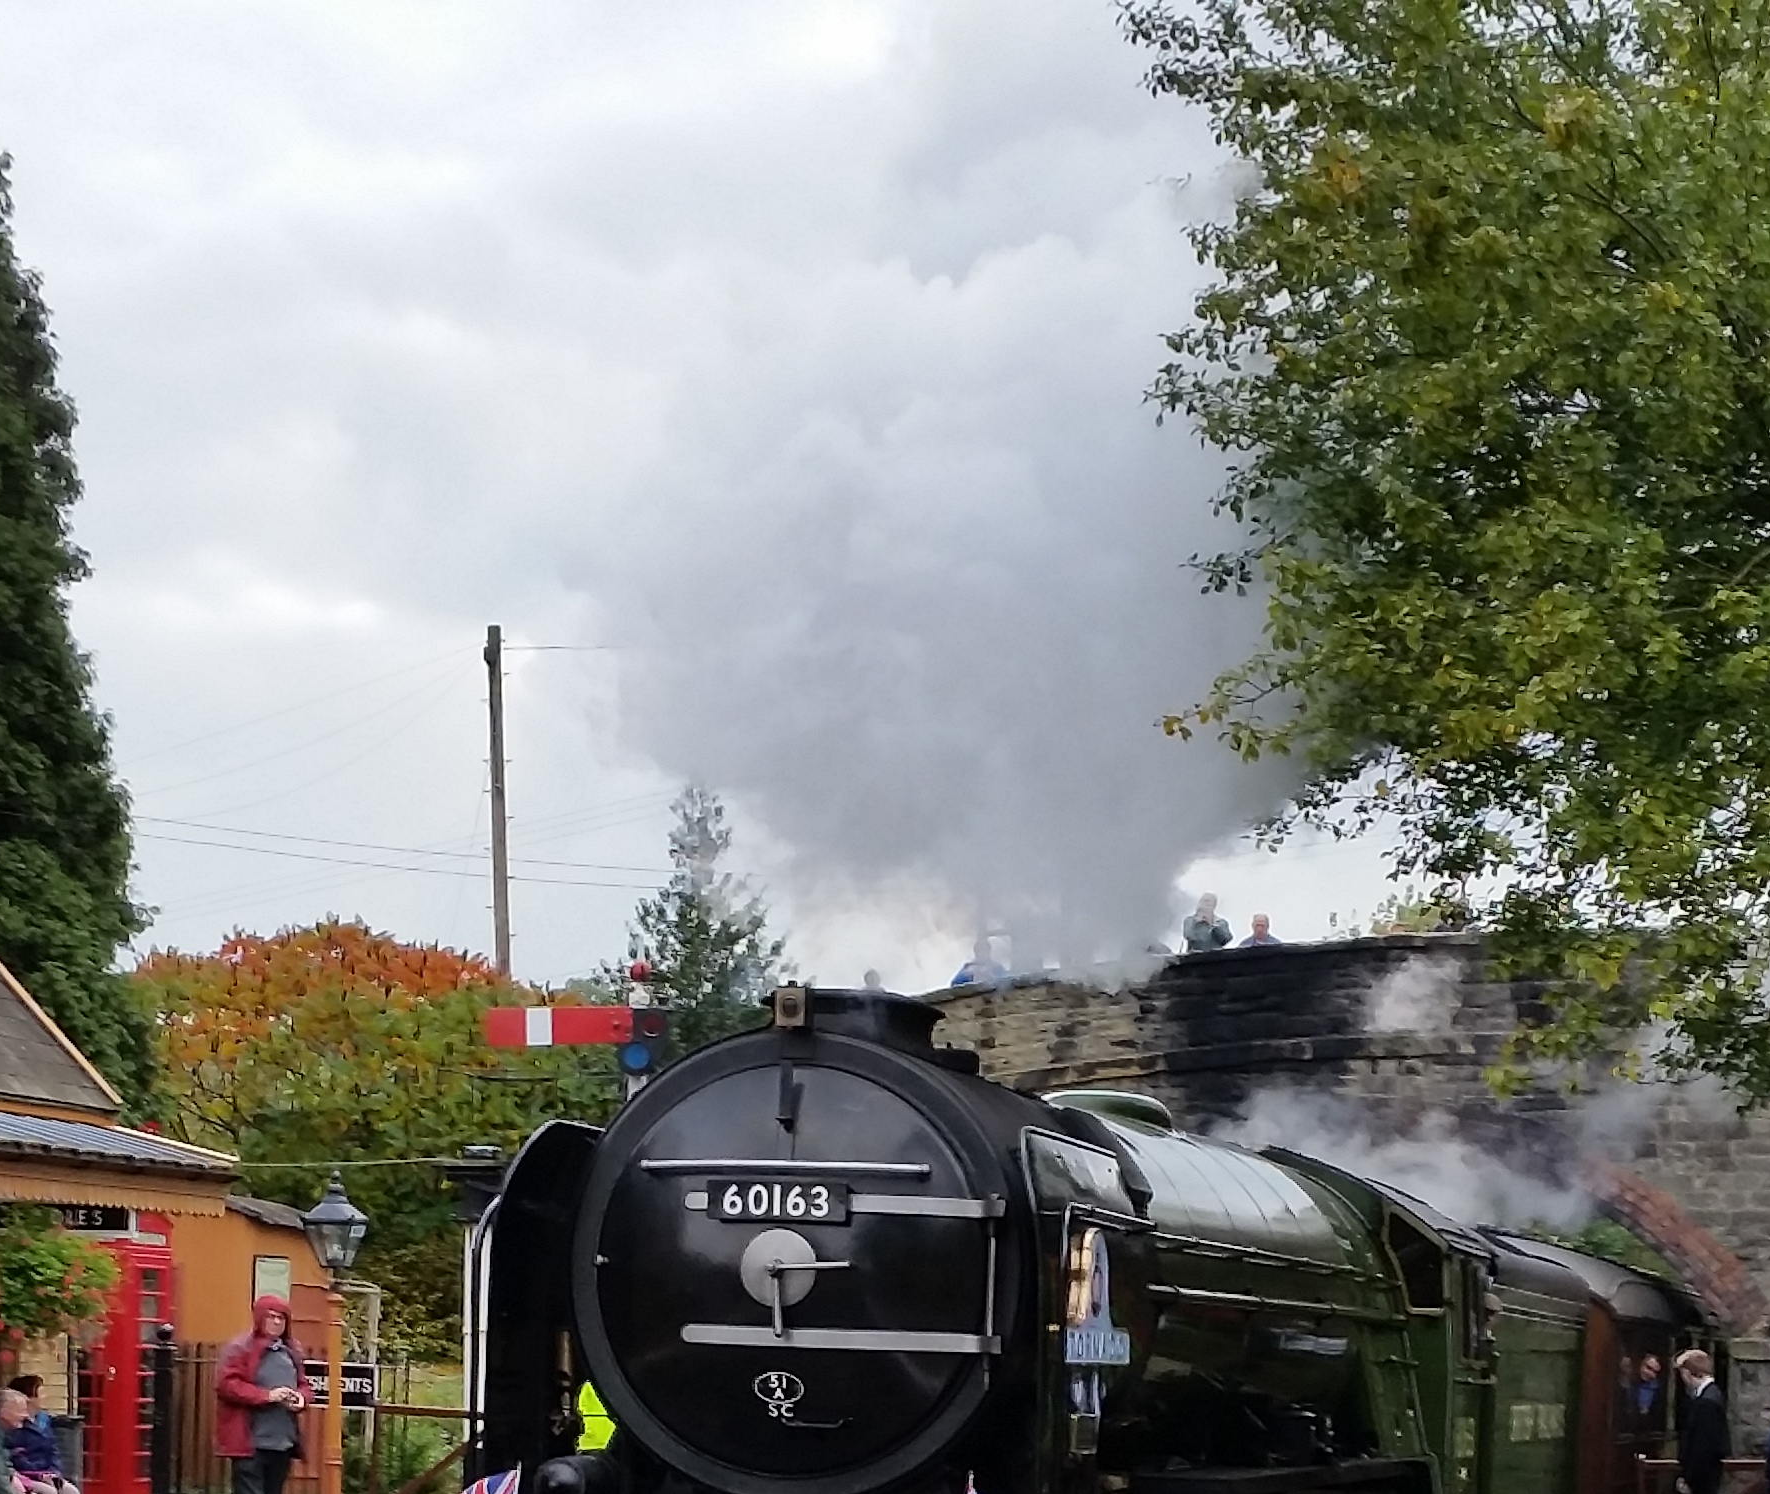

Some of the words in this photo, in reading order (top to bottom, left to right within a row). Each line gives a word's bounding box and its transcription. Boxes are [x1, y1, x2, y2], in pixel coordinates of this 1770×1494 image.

[722, 1183, 829, 1218] 60163
[769, 1374, 787, 1389] 51
[772, 1387, 785, 1399] A
[768, 1403, 794, 1417] SC
